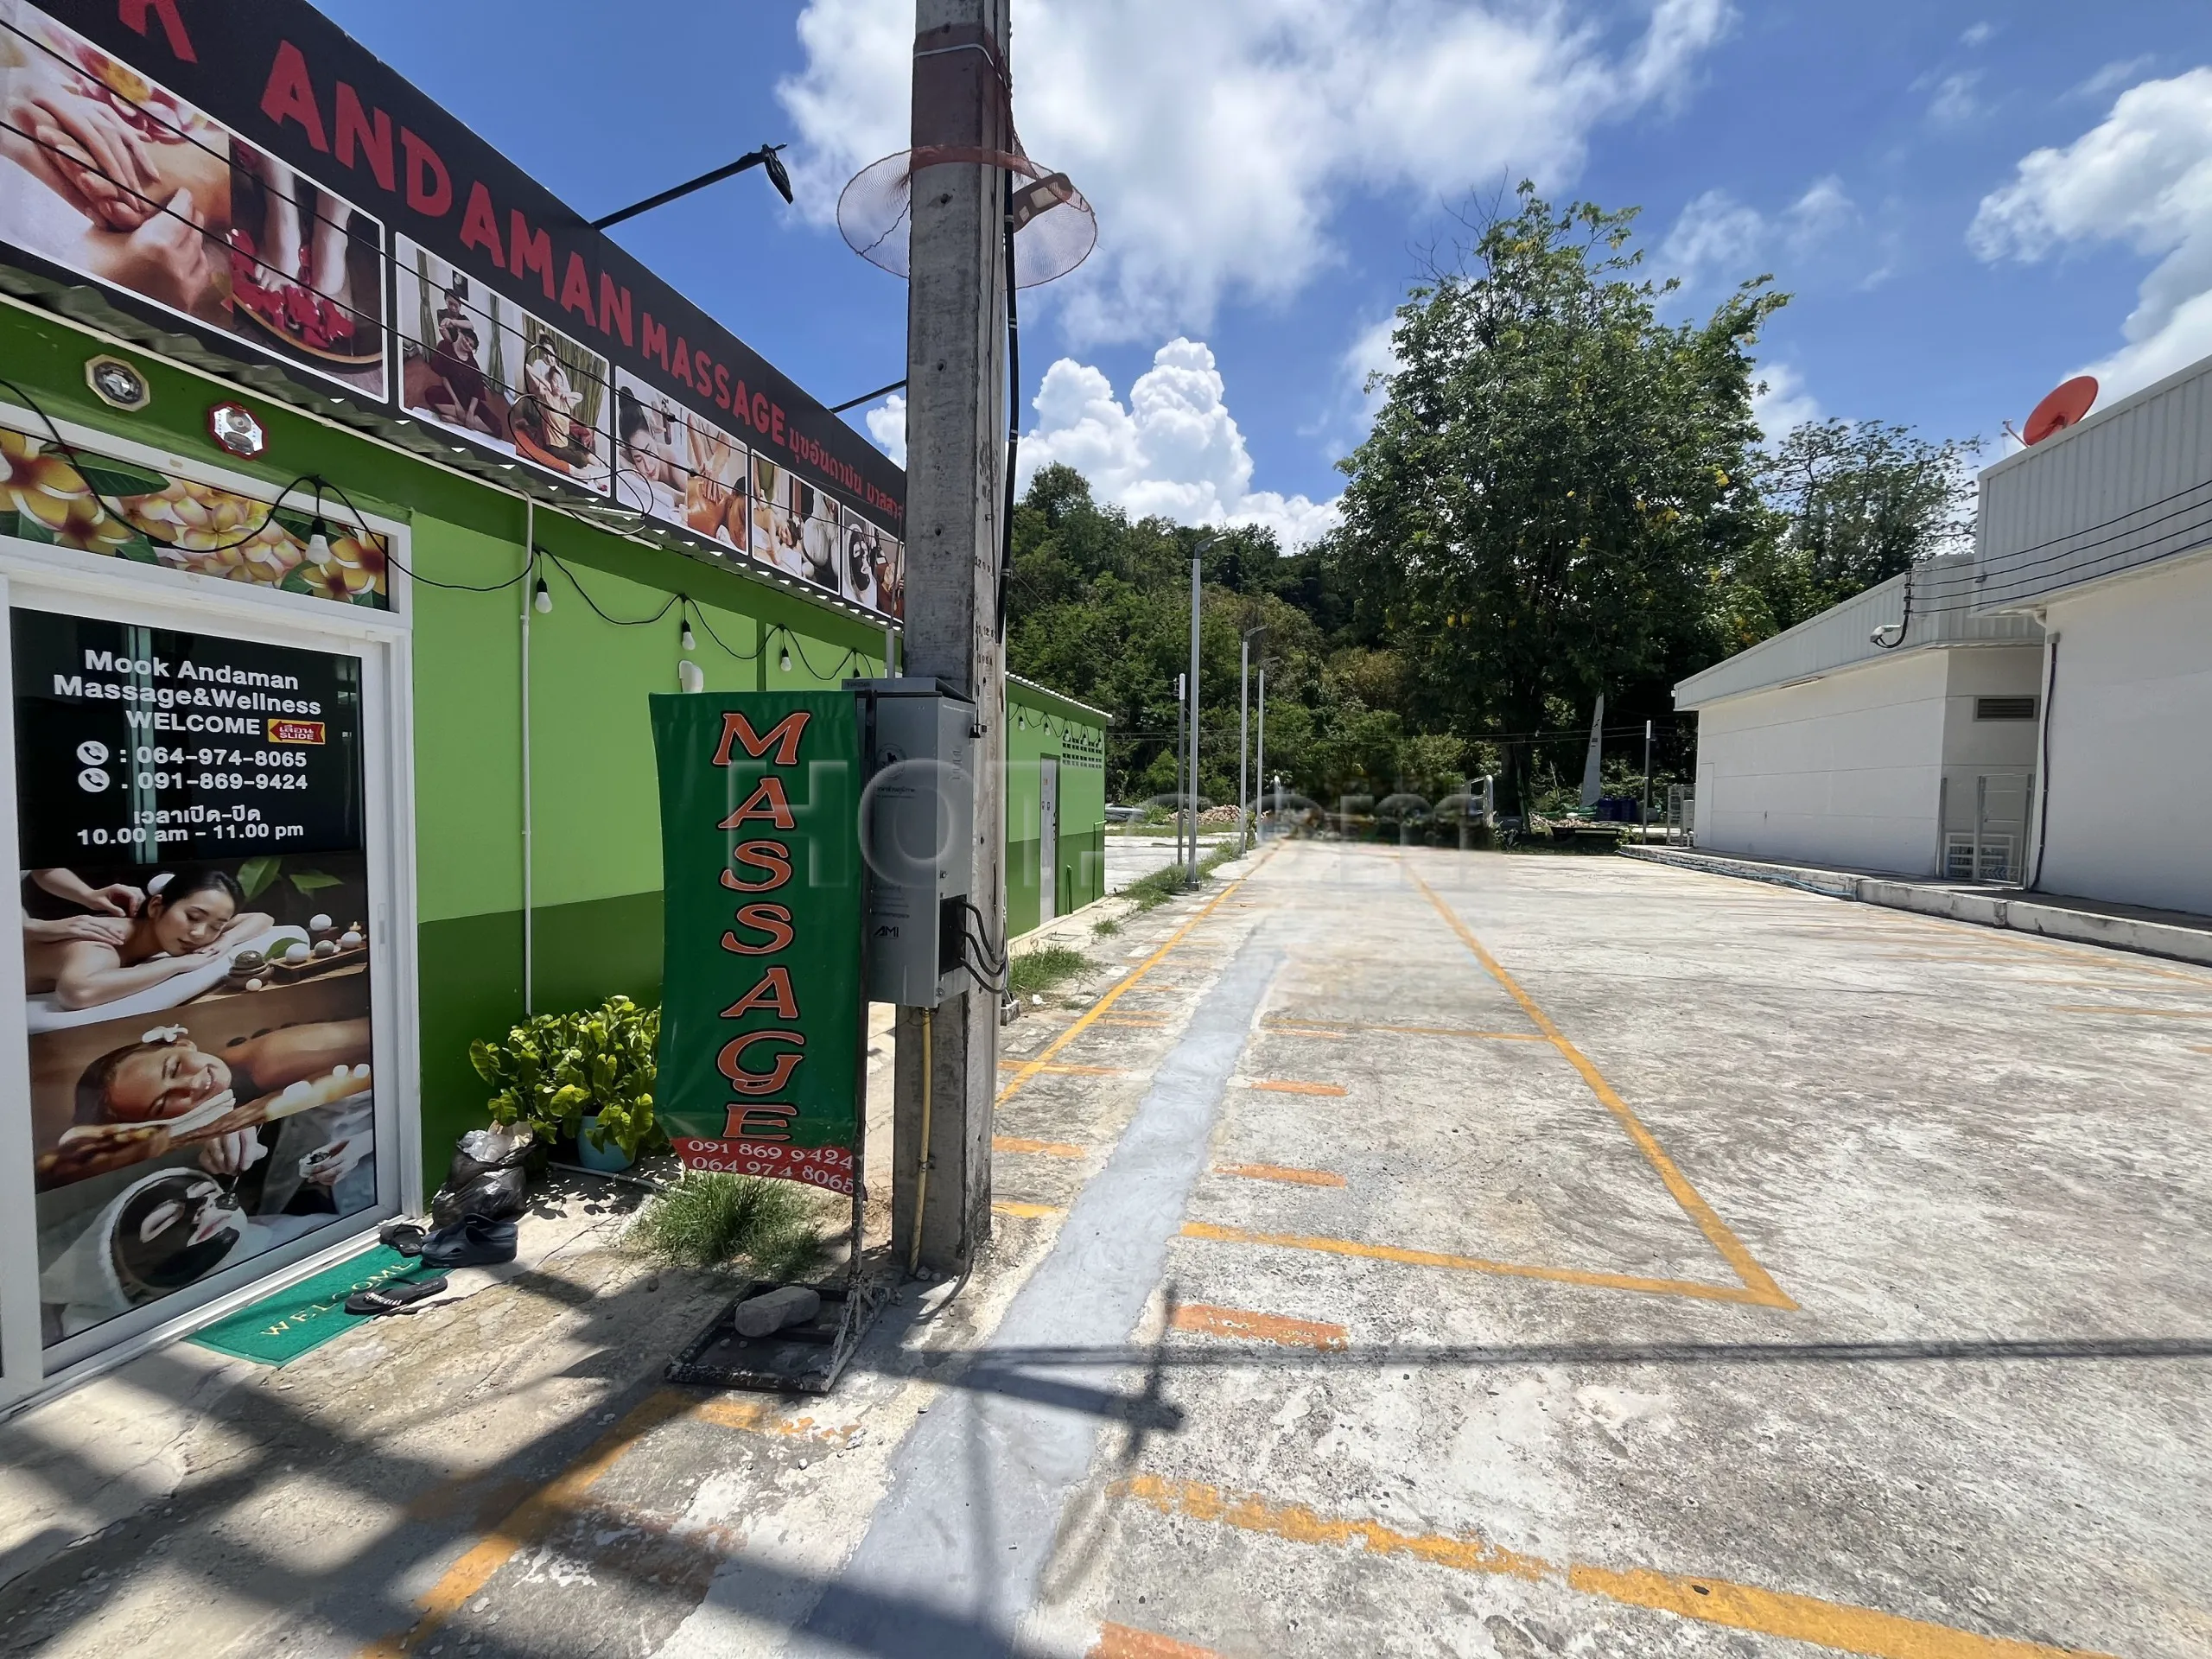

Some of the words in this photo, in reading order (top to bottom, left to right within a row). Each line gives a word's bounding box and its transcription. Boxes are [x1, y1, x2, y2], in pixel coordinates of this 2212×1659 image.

[261, 40, 633, 347] ANDAMAN
[642, 312, 785, 446] MASSAGE
[85, 650, 170, 677] Mook
[178, 660, 299, 690] Andaman
[54, 675, 321, 715] Massage&Wellness
[126, 710, 261, 735] WELCOME
[279, 732, 315, 741] SLIDE
[137, 747, 308, 767] 064-974-8065
[138, 772, 308, 790] 091-869-9424
[77, 826, 147, 845] 10.00
[154, 828, 188, 842] am
[214, 823, 269, 840] 11.00
[276, 823, 304, 841] pm
[711, 710, 811, 1141] MASSAGE
[873, 925, 899, 938] AMI
[688, 1140, 729, 1154] 091
[739, 1143, 782, 1160] 869
[791, 1149, 853, 1170] 9424
[692, 1157, 738, 1173] 064
[802, 1165, 854, 1193] 8065
